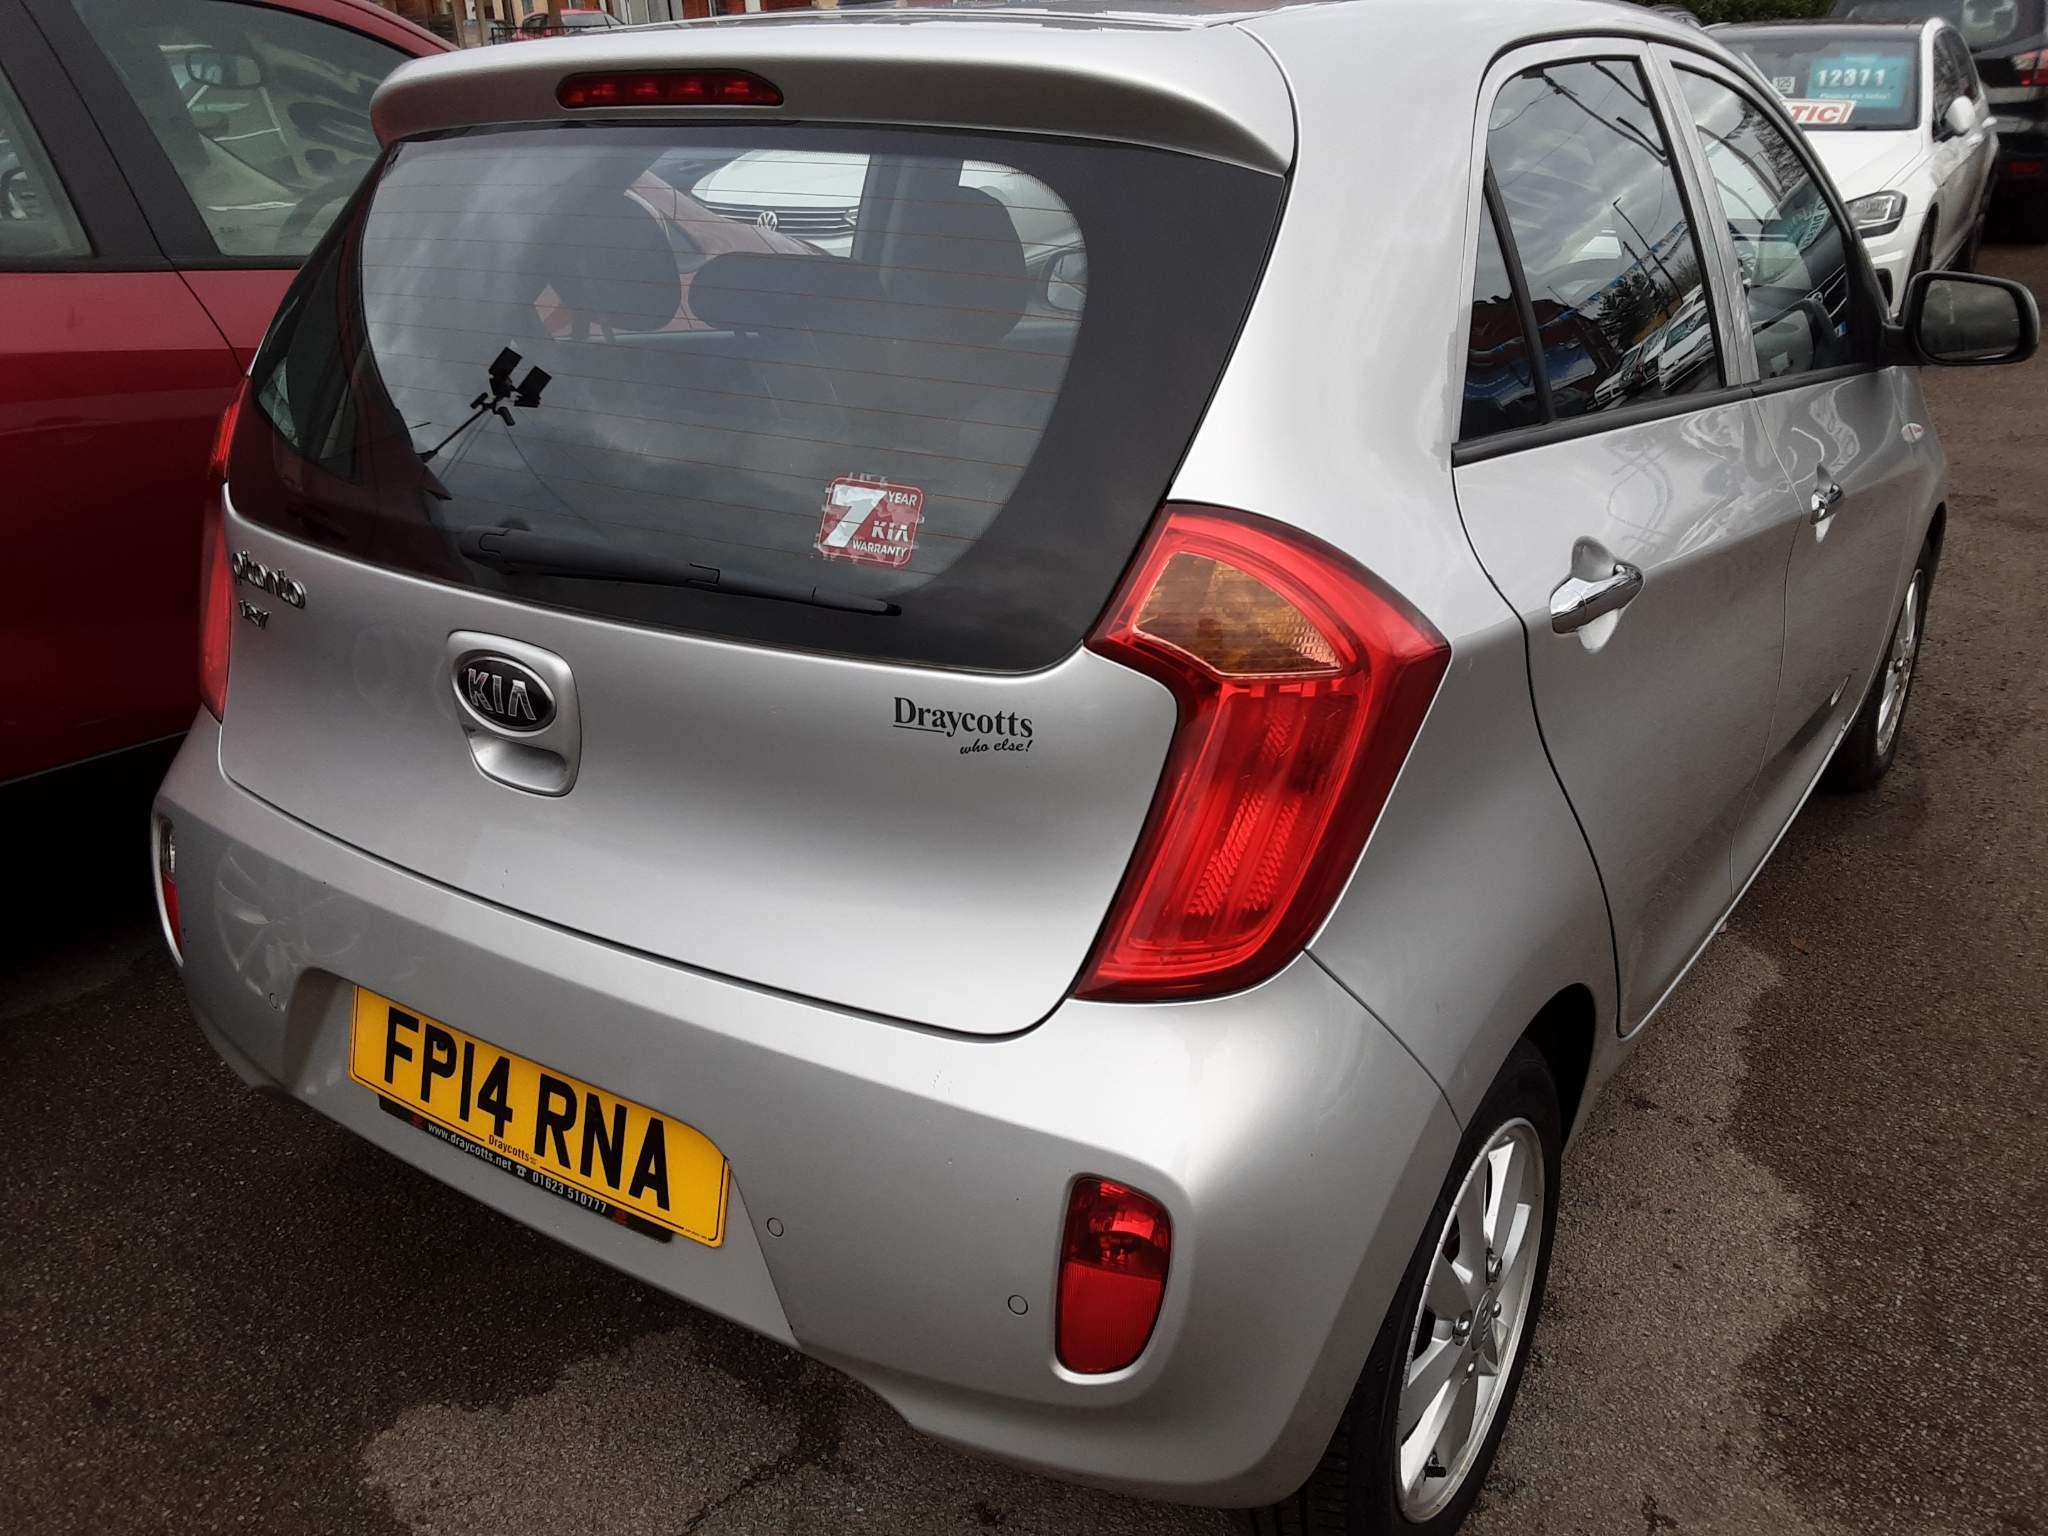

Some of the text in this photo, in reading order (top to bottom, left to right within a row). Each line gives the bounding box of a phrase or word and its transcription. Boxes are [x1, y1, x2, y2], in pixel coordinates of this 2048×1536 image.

[822, 484, 918, 548] 7 YEAR
[872, 520, 909, 542] KIA
[852, 539, 908, 557] WARRANTY
[468, 668, 537, 721] KIA
[894, 696, 1033, 738] Draycotts
[960, 738, 1033, 754] who else!
[384, 1006, 671, 1212] FP14 RNA
[428, 1123, 607, 1213] www.draycotts.net 01623 510777
[488, 1134, 530, 1163] Draycotts
